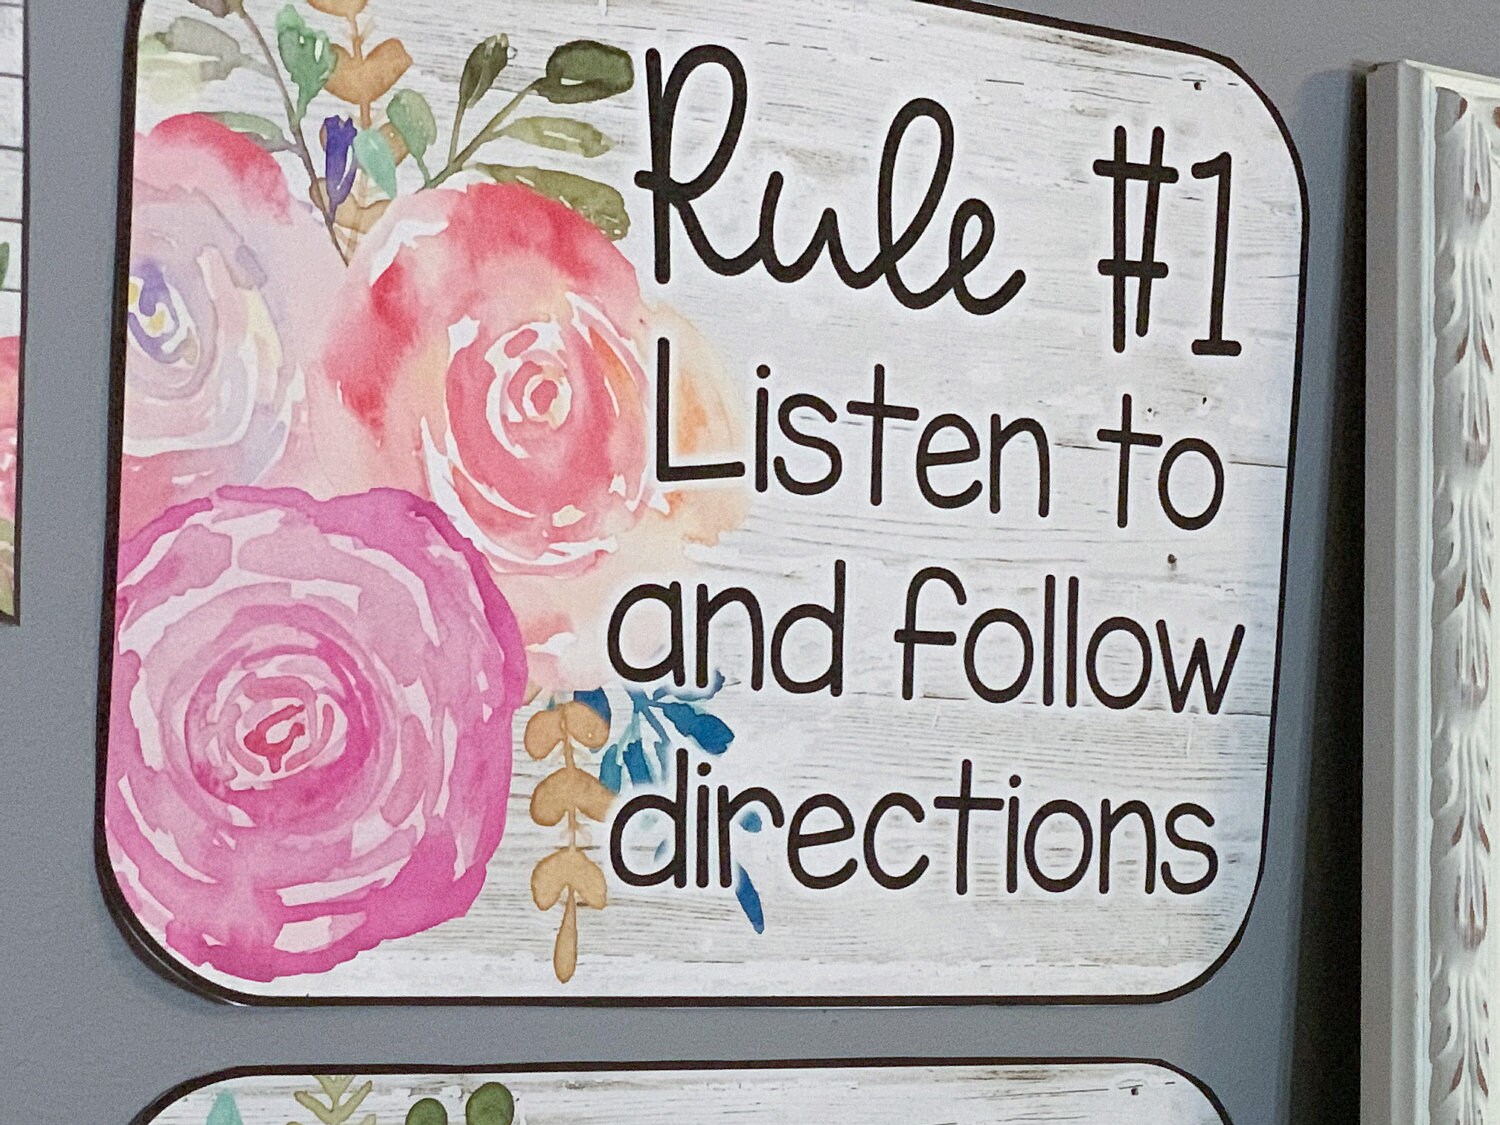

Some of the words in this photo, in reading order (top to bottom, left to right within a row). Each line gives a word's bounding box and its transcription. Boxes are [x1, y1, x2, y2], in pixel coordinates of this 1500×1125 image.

[634, 44, 1026, 315] Rule
[1093, 125, 1241, 357] #1
[655, 336, 1051, 518] Listen
[1096, 393, 1225, 531] to
[607, 559, 847, 697] and
[894, 567, 1246, 715] follow
[609, 748, 1219, 895] directions
